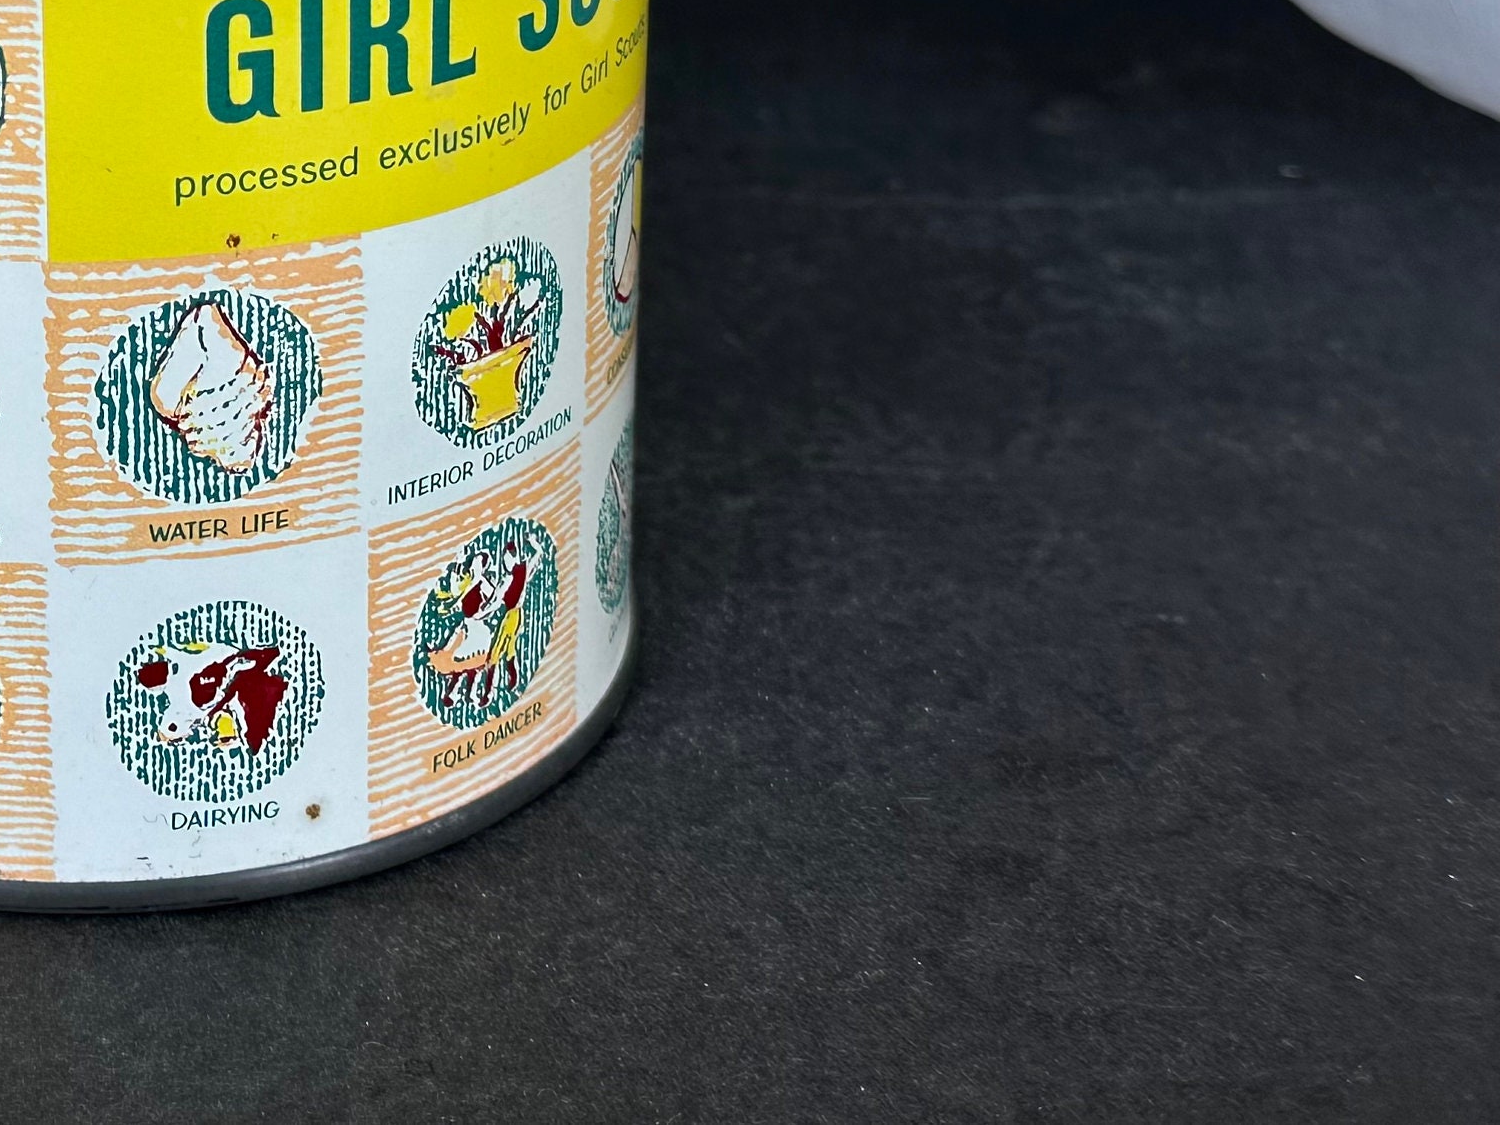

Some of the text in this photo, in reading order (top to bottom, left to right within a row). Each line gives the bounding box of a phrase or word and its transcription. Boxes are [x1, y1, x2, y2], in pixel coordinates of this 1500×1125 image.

[175, 146, 359, 207] processed
[379, 102, 531, 170] exclusively
[543, 82, 572, 117] for
[581, 49, 609, 94] Girl
[387, 406, 573, 506] INTERIOR DECORATION
[148, 508, 290, 544] WATER LIFE
[431, 701, 543, 774] FOLK DANCER
[170, 800, 281, 831] DAIRYING
